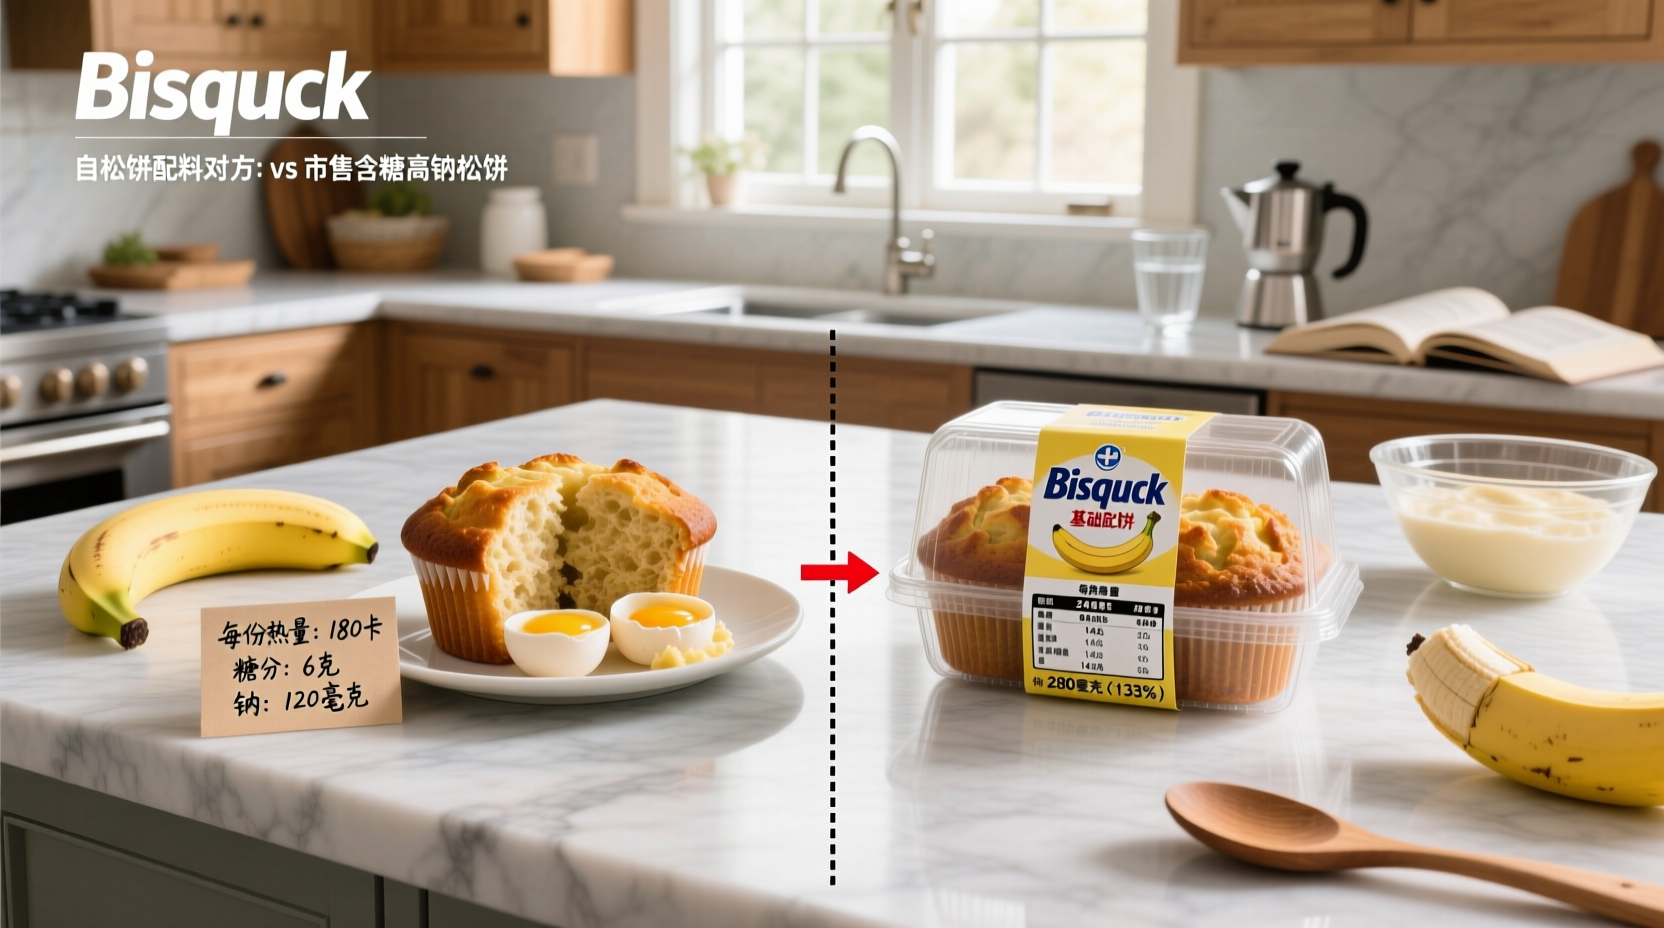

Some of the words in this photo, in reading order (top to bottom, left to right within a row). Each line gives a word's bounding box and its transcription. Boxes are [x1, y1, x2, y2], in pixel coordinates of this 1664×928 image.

[1043, 467, 1169, 511] Bisquck
[302, 651, 340, 679] 6克
[285, 681, 369, 713] 120毫克
